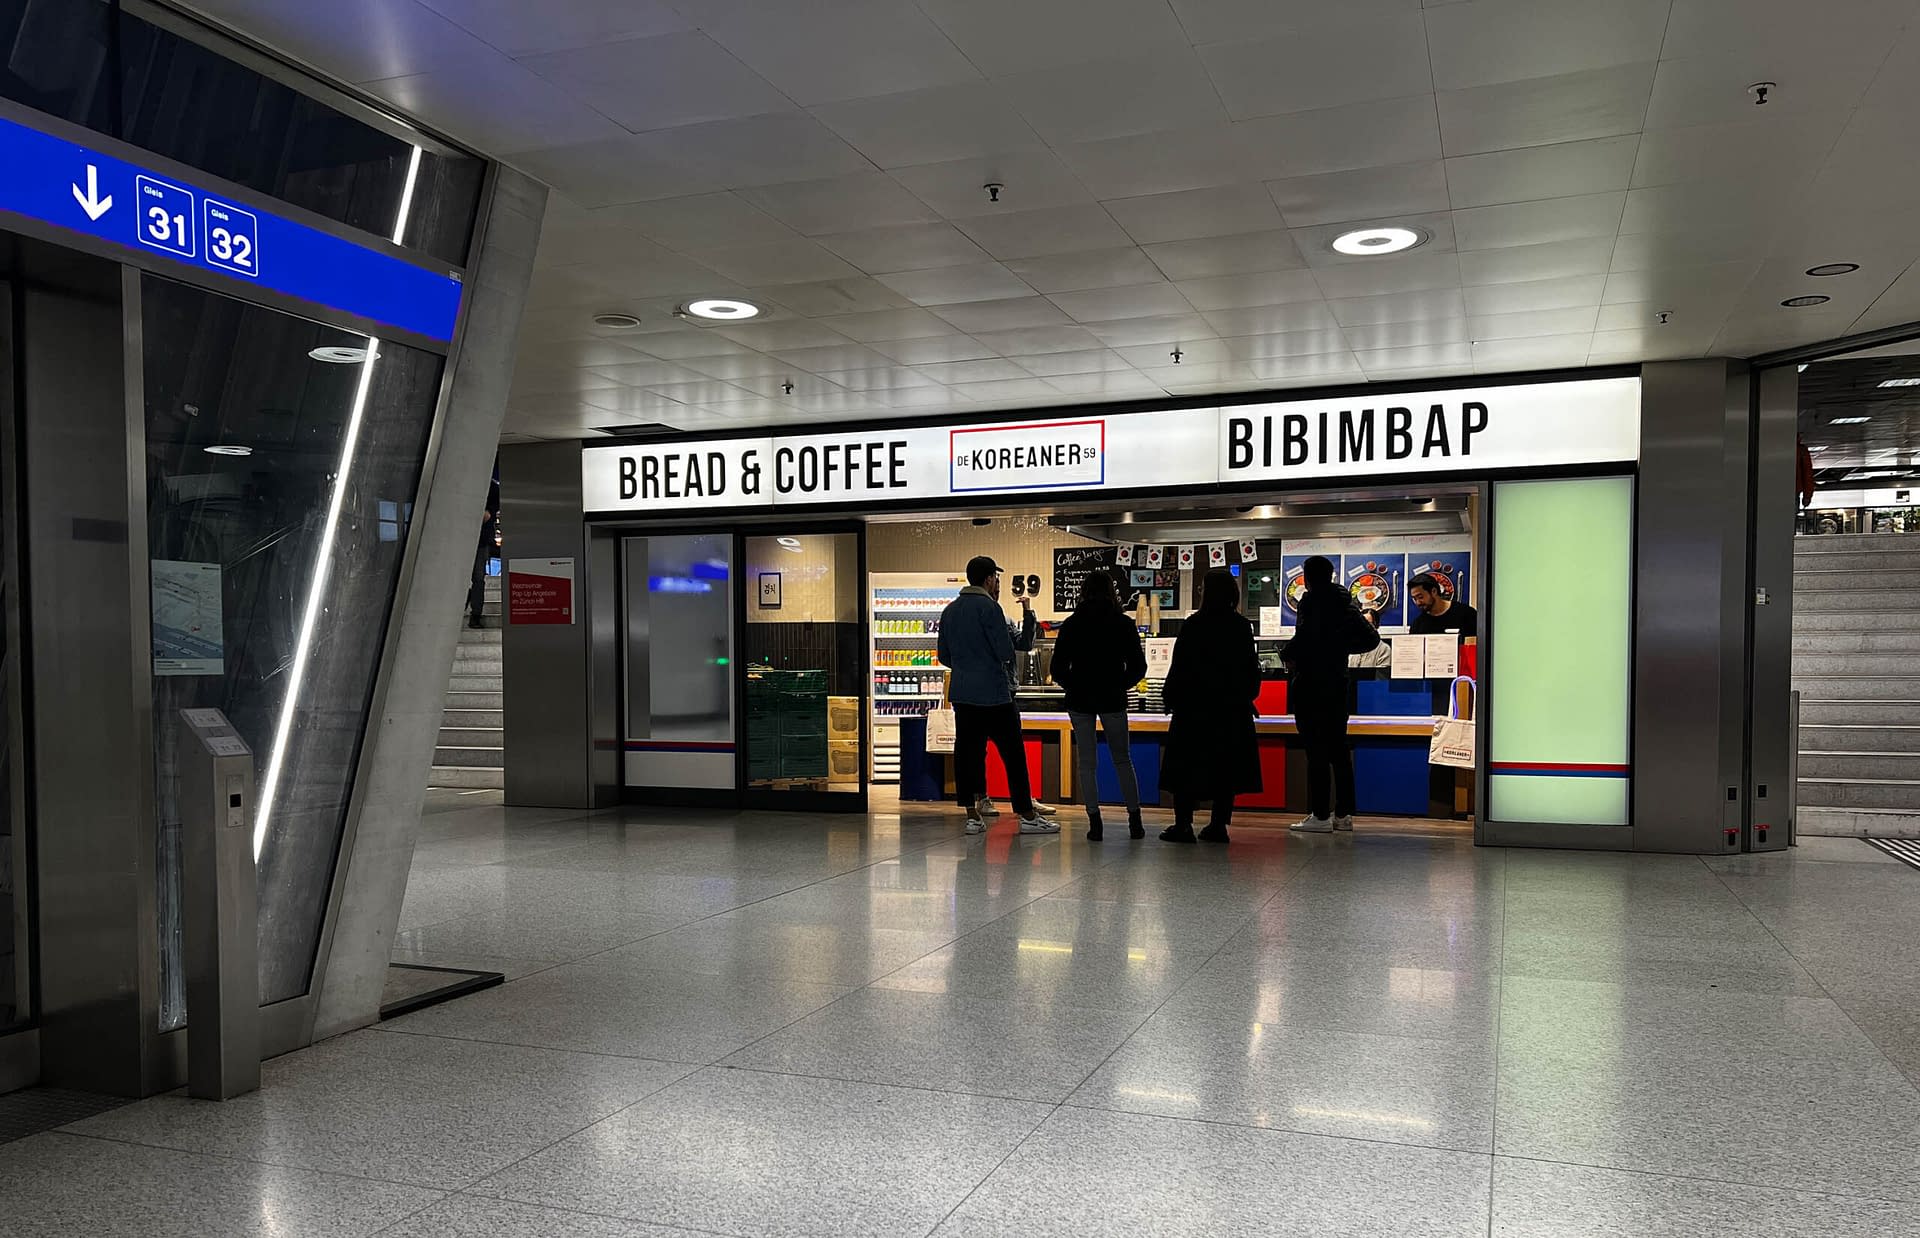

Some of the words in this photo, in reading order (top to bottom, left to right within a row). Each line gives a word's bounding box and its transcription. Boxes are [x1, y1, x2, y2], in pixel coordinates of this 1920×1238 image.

[144, 186, 163, 199] Gleis
[148, 206, 186, 247] 31
[211, 209, 229, 221] Gleis
[212, 227, 252, 268] 32
[1228, 401, 1489, 470] BIBIMBAP
[619, 451, 726, 500] BREAD
[740, 449, 762, 495] &
[775, 440, 908, 494] COFFEE
[957, 455, 969, 467] DE
[972, 443, 1081, 471] KOREANER
[1083, 447, 1096, 459] 59
[1011, 574, 1041, 598] 59
